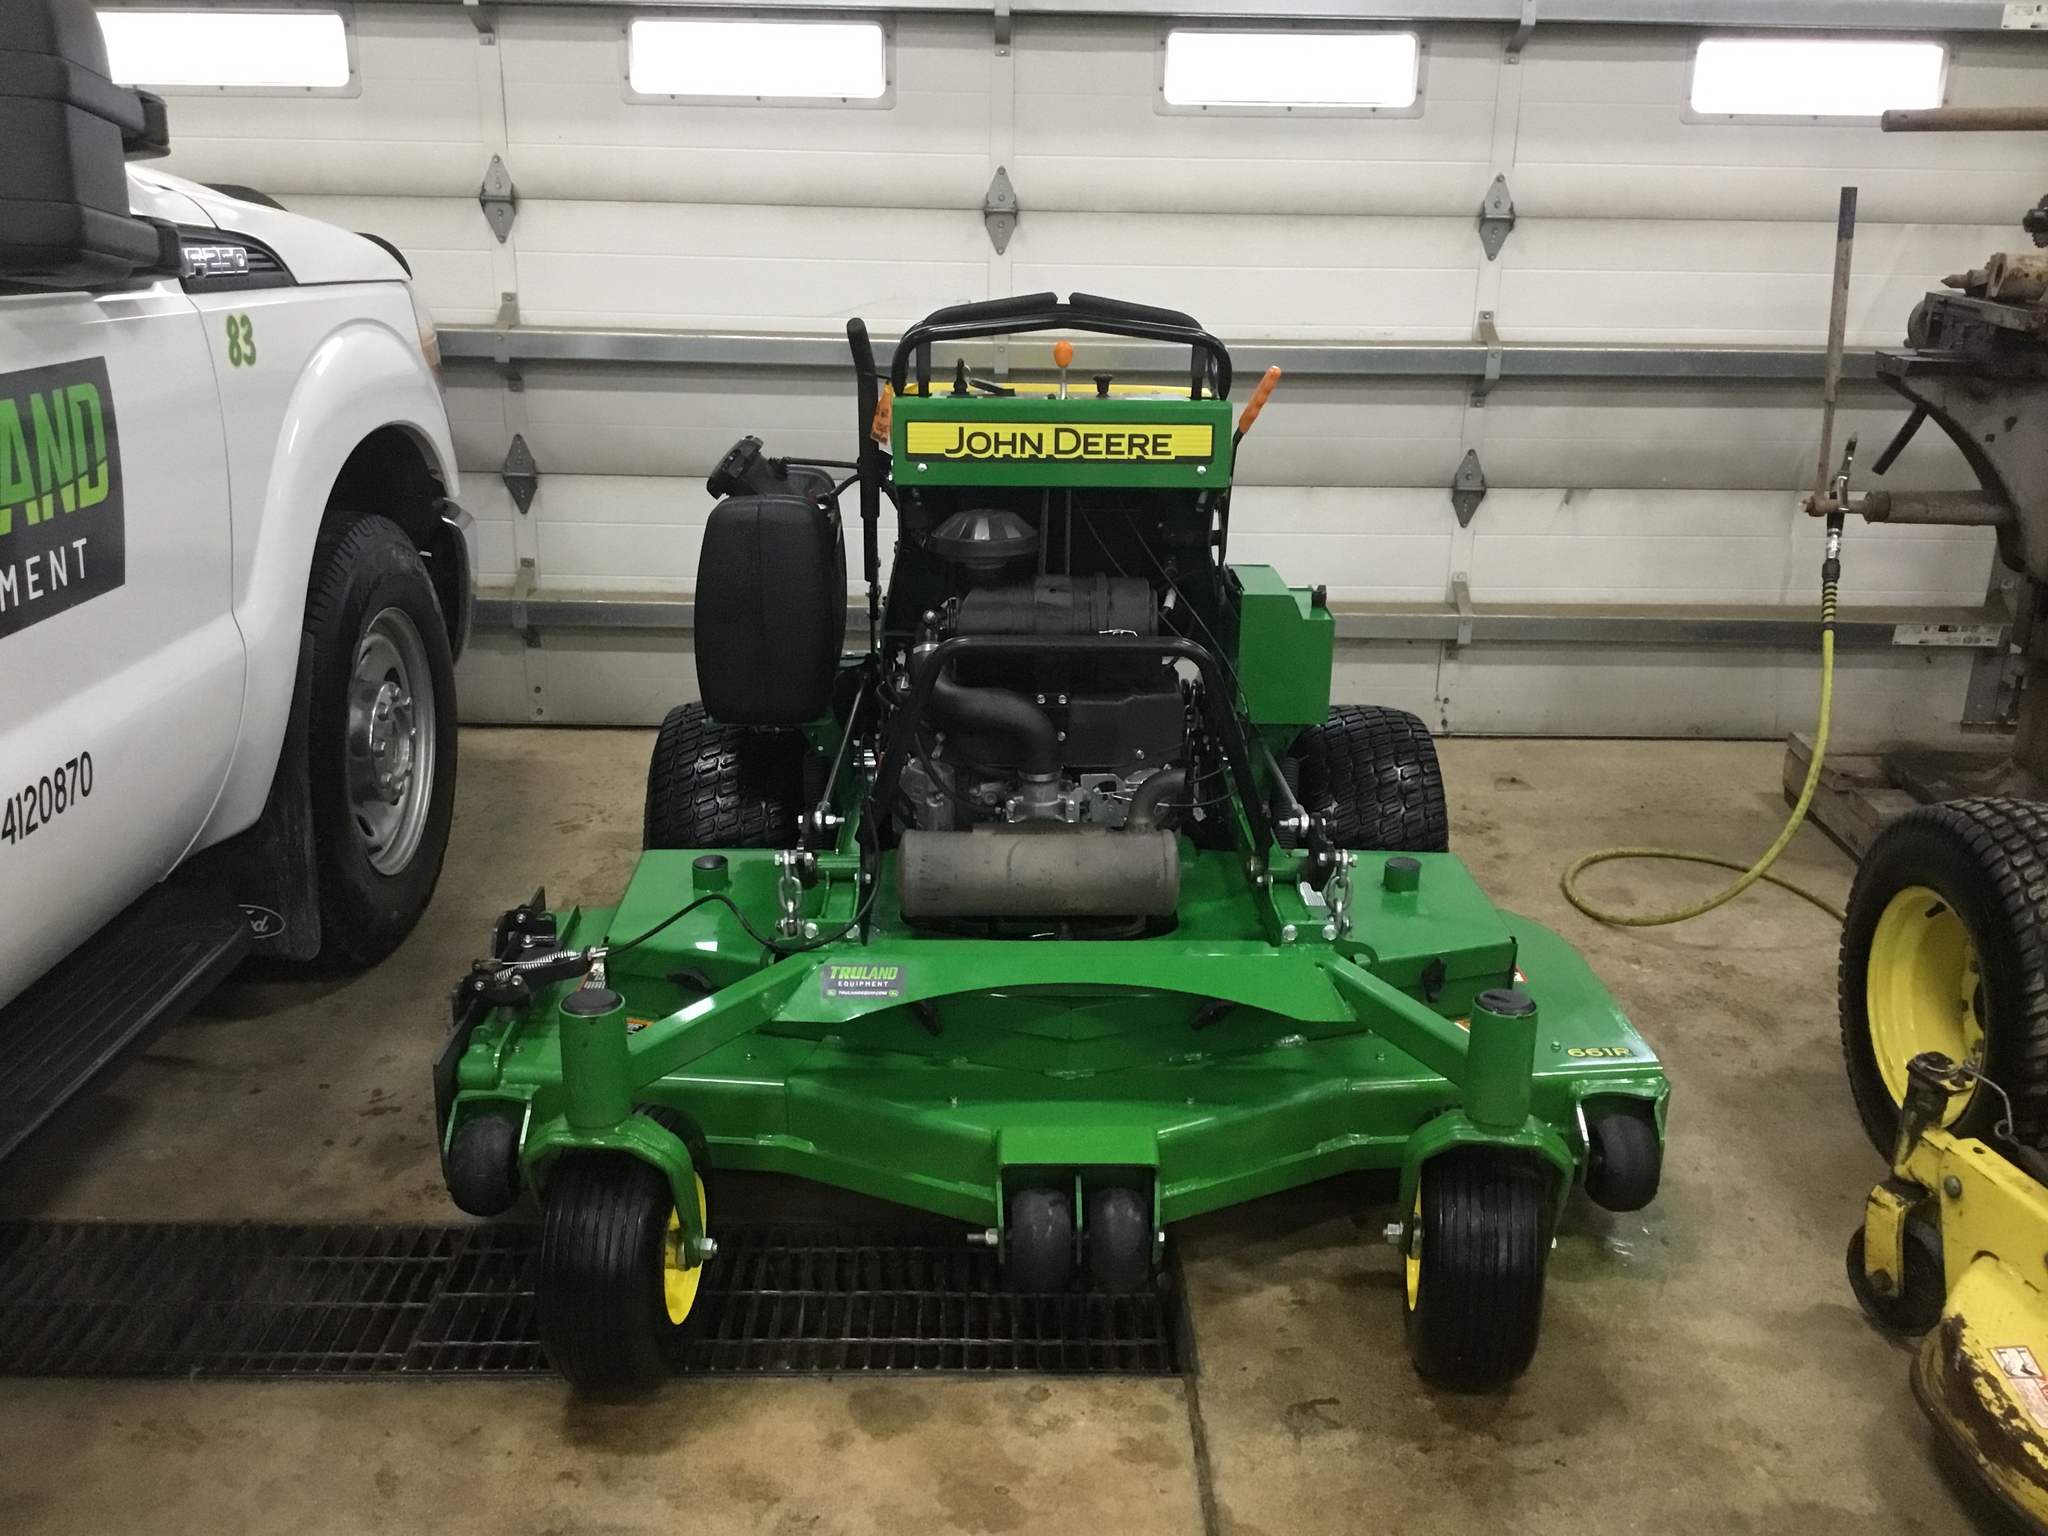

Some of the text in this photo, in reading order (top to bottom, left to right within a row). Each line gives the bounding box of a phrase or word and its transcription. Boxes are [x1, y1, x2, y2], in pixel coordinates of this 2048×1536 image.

[225, 312, 257, 369] 83
[944, 426, 1173, 457] JOHN DEERE
[0, 537, 88, 612] MENT
[1, 751, 93, 845] 4120870
[830, 966, 899, 980] TRULAND
[1567, 1047, 1634, 1058] 661R
